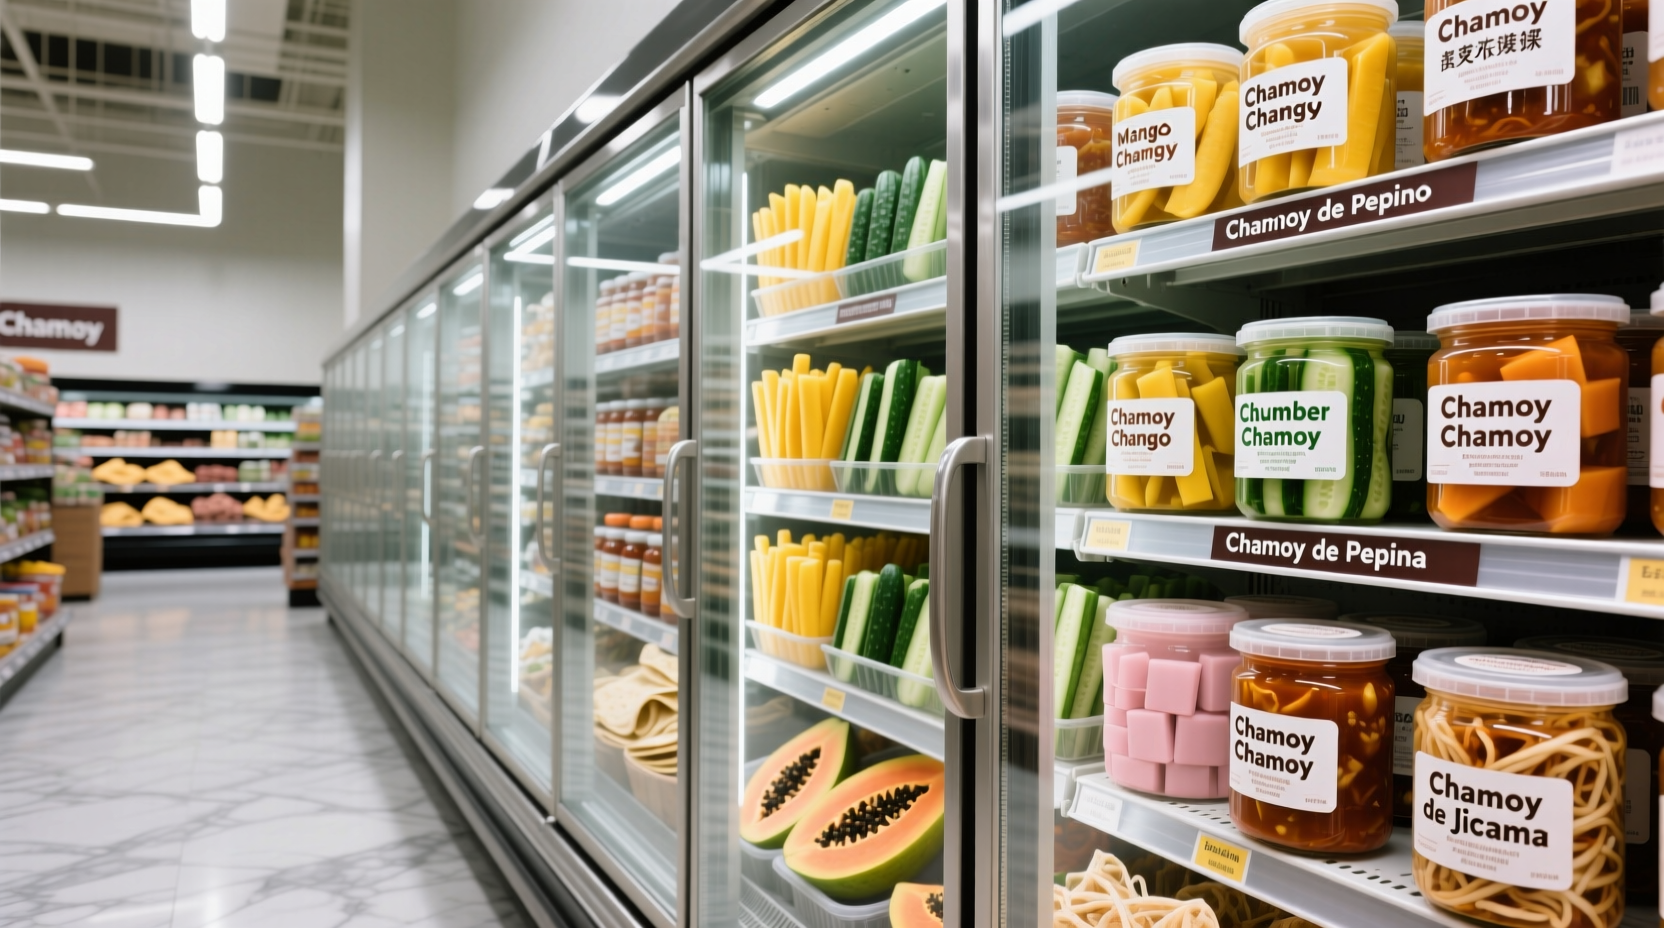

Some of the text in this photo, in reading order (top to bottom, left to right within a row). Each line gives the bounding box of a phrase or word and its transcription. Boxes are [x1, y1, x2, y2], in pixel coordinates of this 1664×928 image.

[1438, 0, 1547, 43] Chamoy
[1244, 74, 1326, 107] Chamoy
[1245, 100, 1322, 131] Changy
[1118, 123, 1171, 147] Mango
[1225, 184, 1432, 240] Chamoy de Pepino
[0, 310, 103, 346] Chamoy
[1110, 407, 1175, 430] Chamoy
[1240, 400, 1330, 423] Chumber
[1440, 394, 1552, 423] Chamoy
[1111, 429, 1171, 451] Chango
[1241, 426, 1321, 450] Chamoy
[1440, 424, 1552, 453] Chamoy
[1225, 532, 1427, 571] Chamoy de Pepina
[1234, 715, 1315, 756] Chamoy
[1234, 739, 1314, 781] Chamoy
[1429, 771, 1543, 821] Chamoy
[1423, 797, 1446, 825] de
[1449, 807, 1549, 848] Jicama
